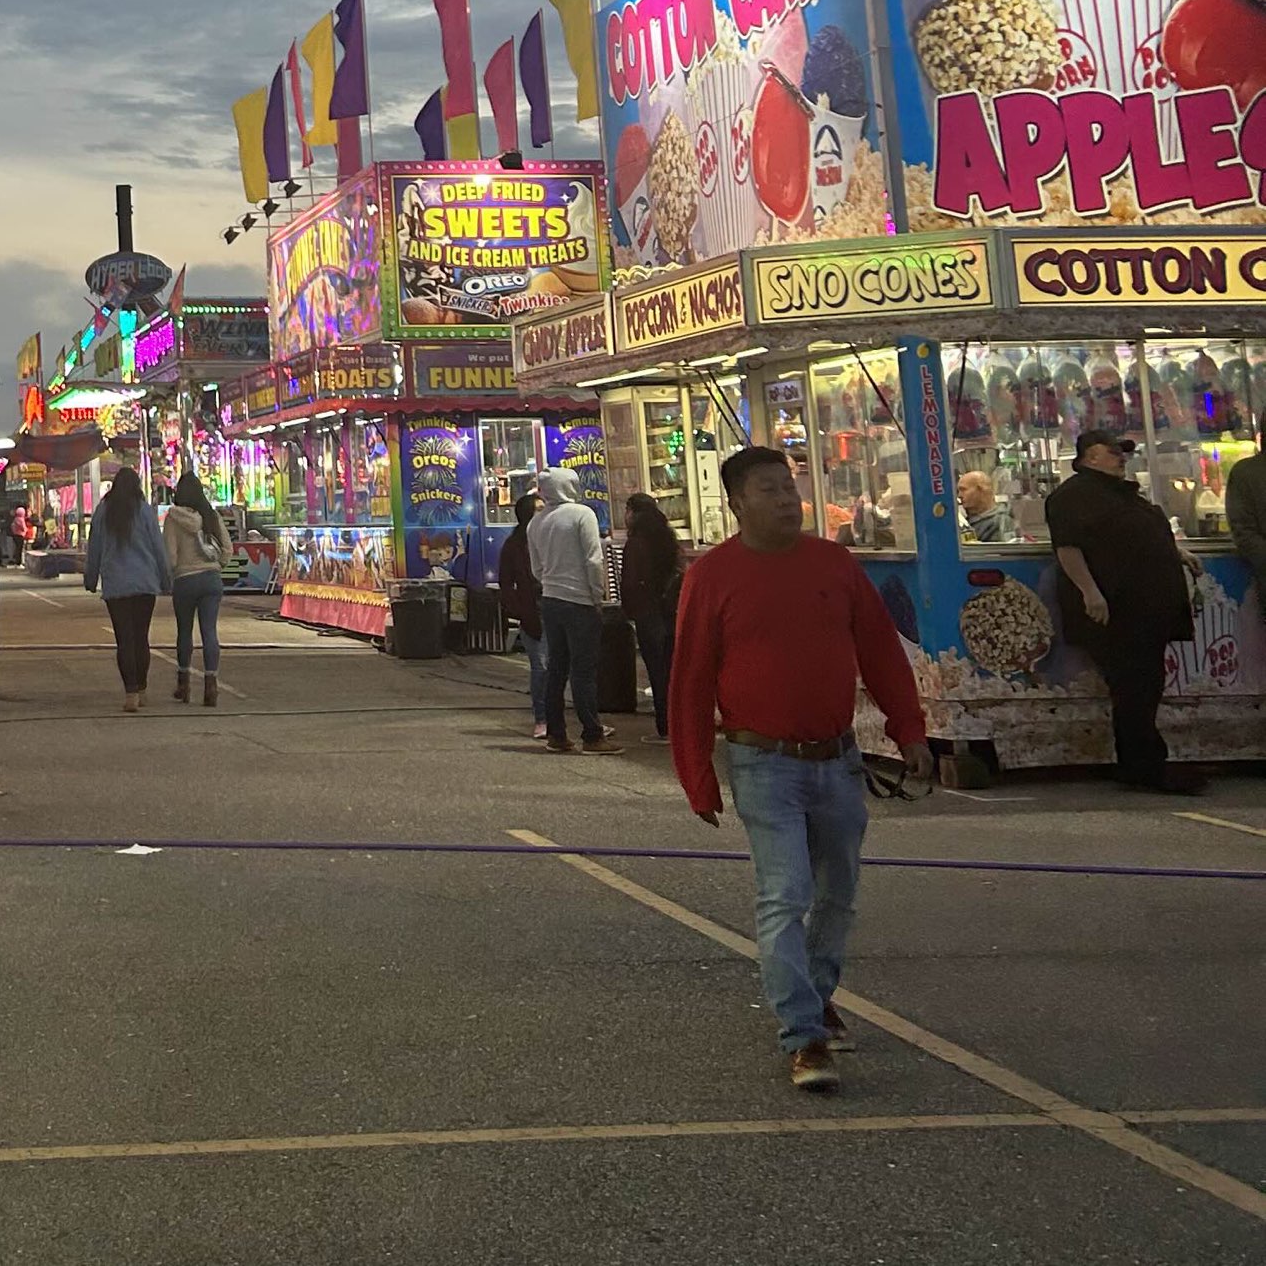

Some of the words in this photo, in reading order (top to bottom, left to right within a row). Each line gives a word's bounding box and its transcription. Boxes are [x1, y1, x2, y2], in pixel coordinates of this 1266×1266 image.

[442, 181, 487, 203] DEEP
[491, 181, 544, 202] FRIED
[423, 207, 568, 239] SWEETS
[409, 241, 442, 263] AND
[446, 245, 469, 266] ICE
[473, 247, 525, 267] CREAM
[529, 239, 586, 266] TREATS
[769, 262, 848, 314] SNO
[852, 250, 981, 306] CONES
[1024, 245, 1228, 297] COTTON
[464, 275, 525, 295] OREO
[449, 295, 494, 314] SNICKERS
[500, 293, 569, 316] Twinkies
[625, 287, 679, 343] POPCORN
[688, 271, 742, 328] NACHOS
[320, 367, 392, 390] FLOATS
[429, 367, 516, 389] FUNNE
[407, 417, 457, 432] Twinkies
[921, 365, 944, 495] LEMONADE
[413, 455, 457, 469] Oreos
[560, 452, 591, 469] Funnel
[411, 489, 462, 504] Snickers
[585, 489, 609, 499] Crea
